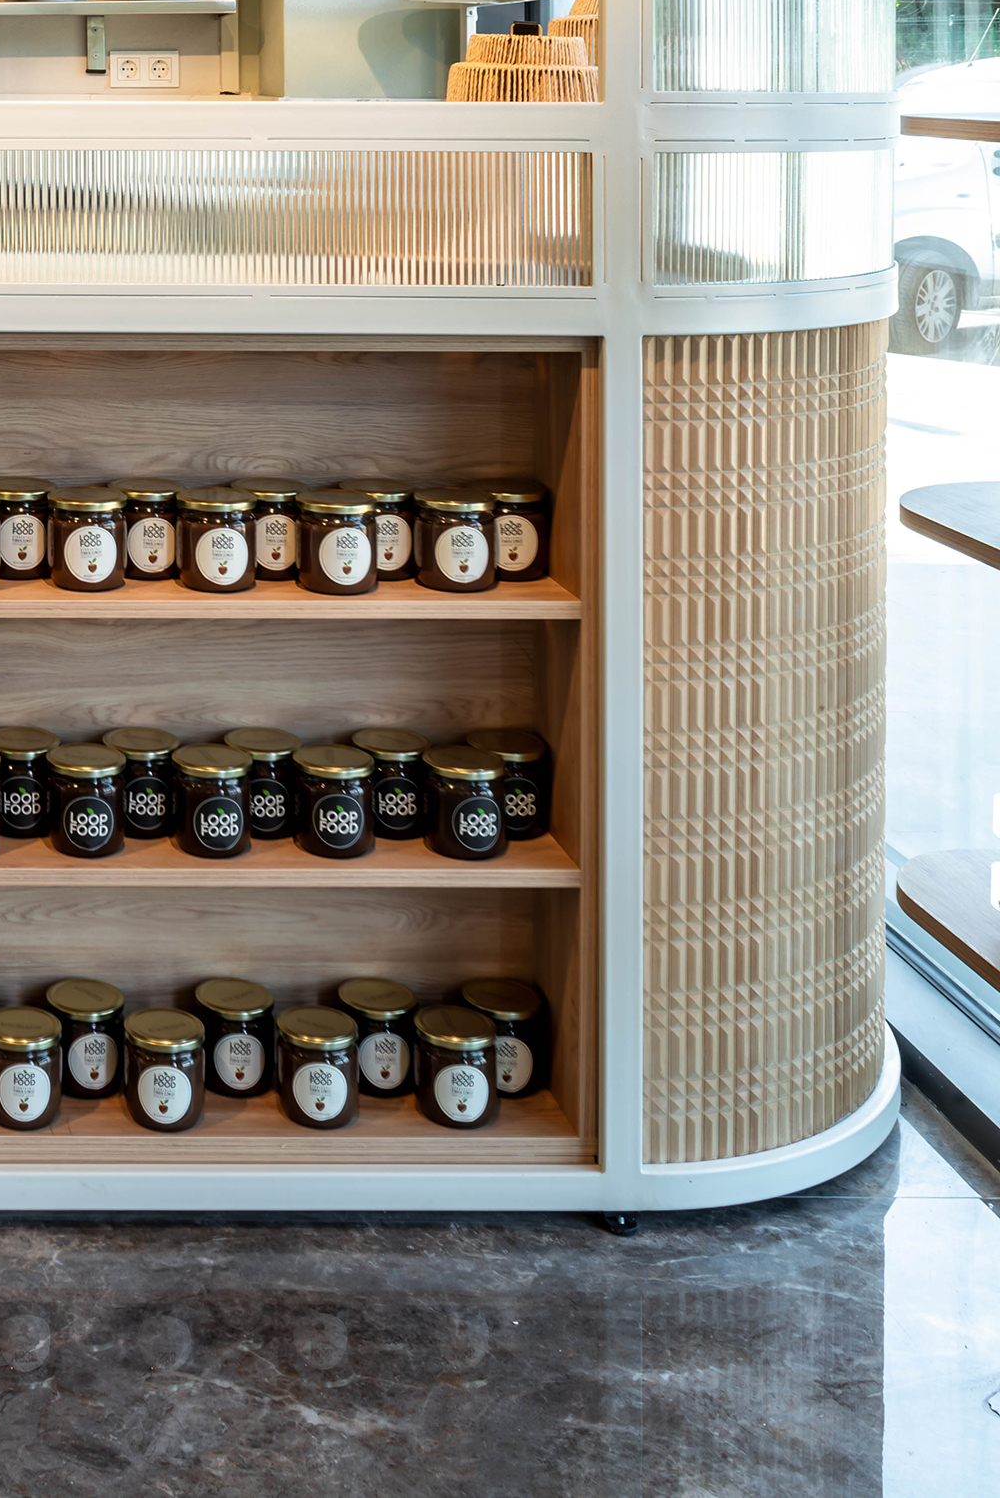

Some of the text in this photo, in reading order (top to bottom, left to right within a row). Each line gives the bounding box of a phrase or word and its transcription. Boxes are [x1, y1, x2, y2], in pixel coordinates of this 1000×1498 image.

[80, 534, 101, 542] LOOP
[4, 792, 40, 804] LOOP
[130, 791, 166, 805] LOOP
[378, 792, 416, 805] LOOP
[505, 793, 535, 806] OOP
[4, 803, 40, 815] FOOD
[130, 802, 166, 816] FOOD
[319, 808, 358, 823] LOOP
[378, 803, 417, 816] FOOD
[505, 804, 536, 816] OOD
[70, 811, 108, 826] LOOP
[200, 813, 238, 826] LOOP
[460, 812, 497, 826] LOOP
[70, 824, 108, 837] FOOD
[200, 824, 239, 837] FOOD
[319, 821, 359, 834] FOOD
[460, 824, 497, 837] FOOD
[14, 1072, 35, 1080] LOOP
